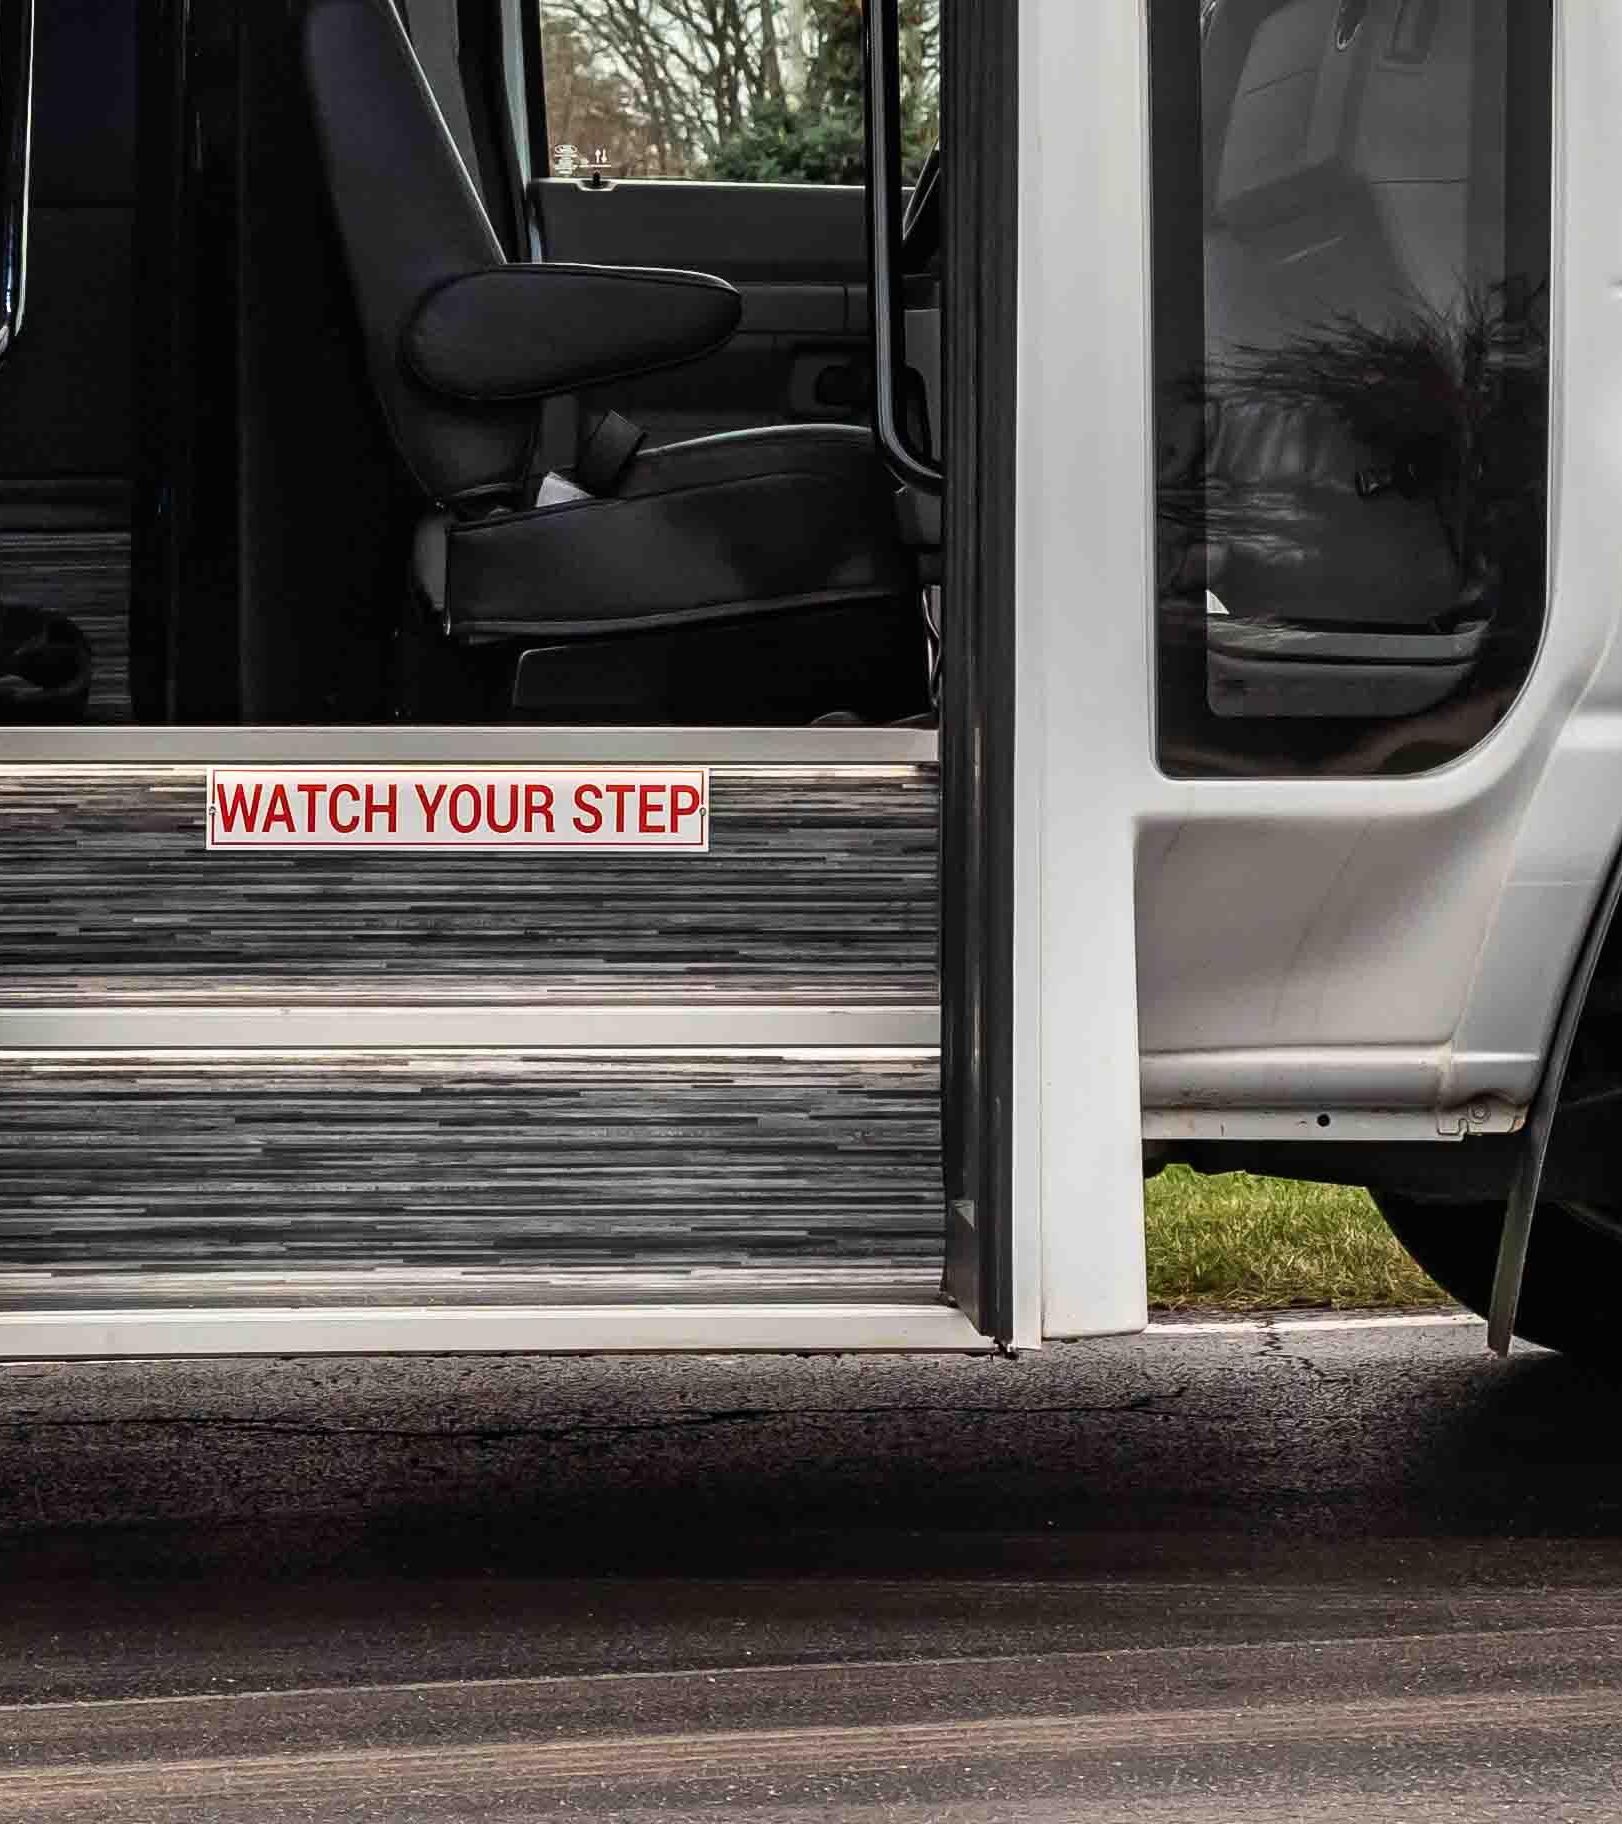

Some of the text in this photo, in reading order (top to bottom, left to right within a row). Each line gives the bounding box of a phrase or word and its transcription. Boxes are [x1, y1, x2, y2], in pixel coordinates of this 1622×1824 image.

[216, 782, 701, 833] WATCH YOUR STEP
